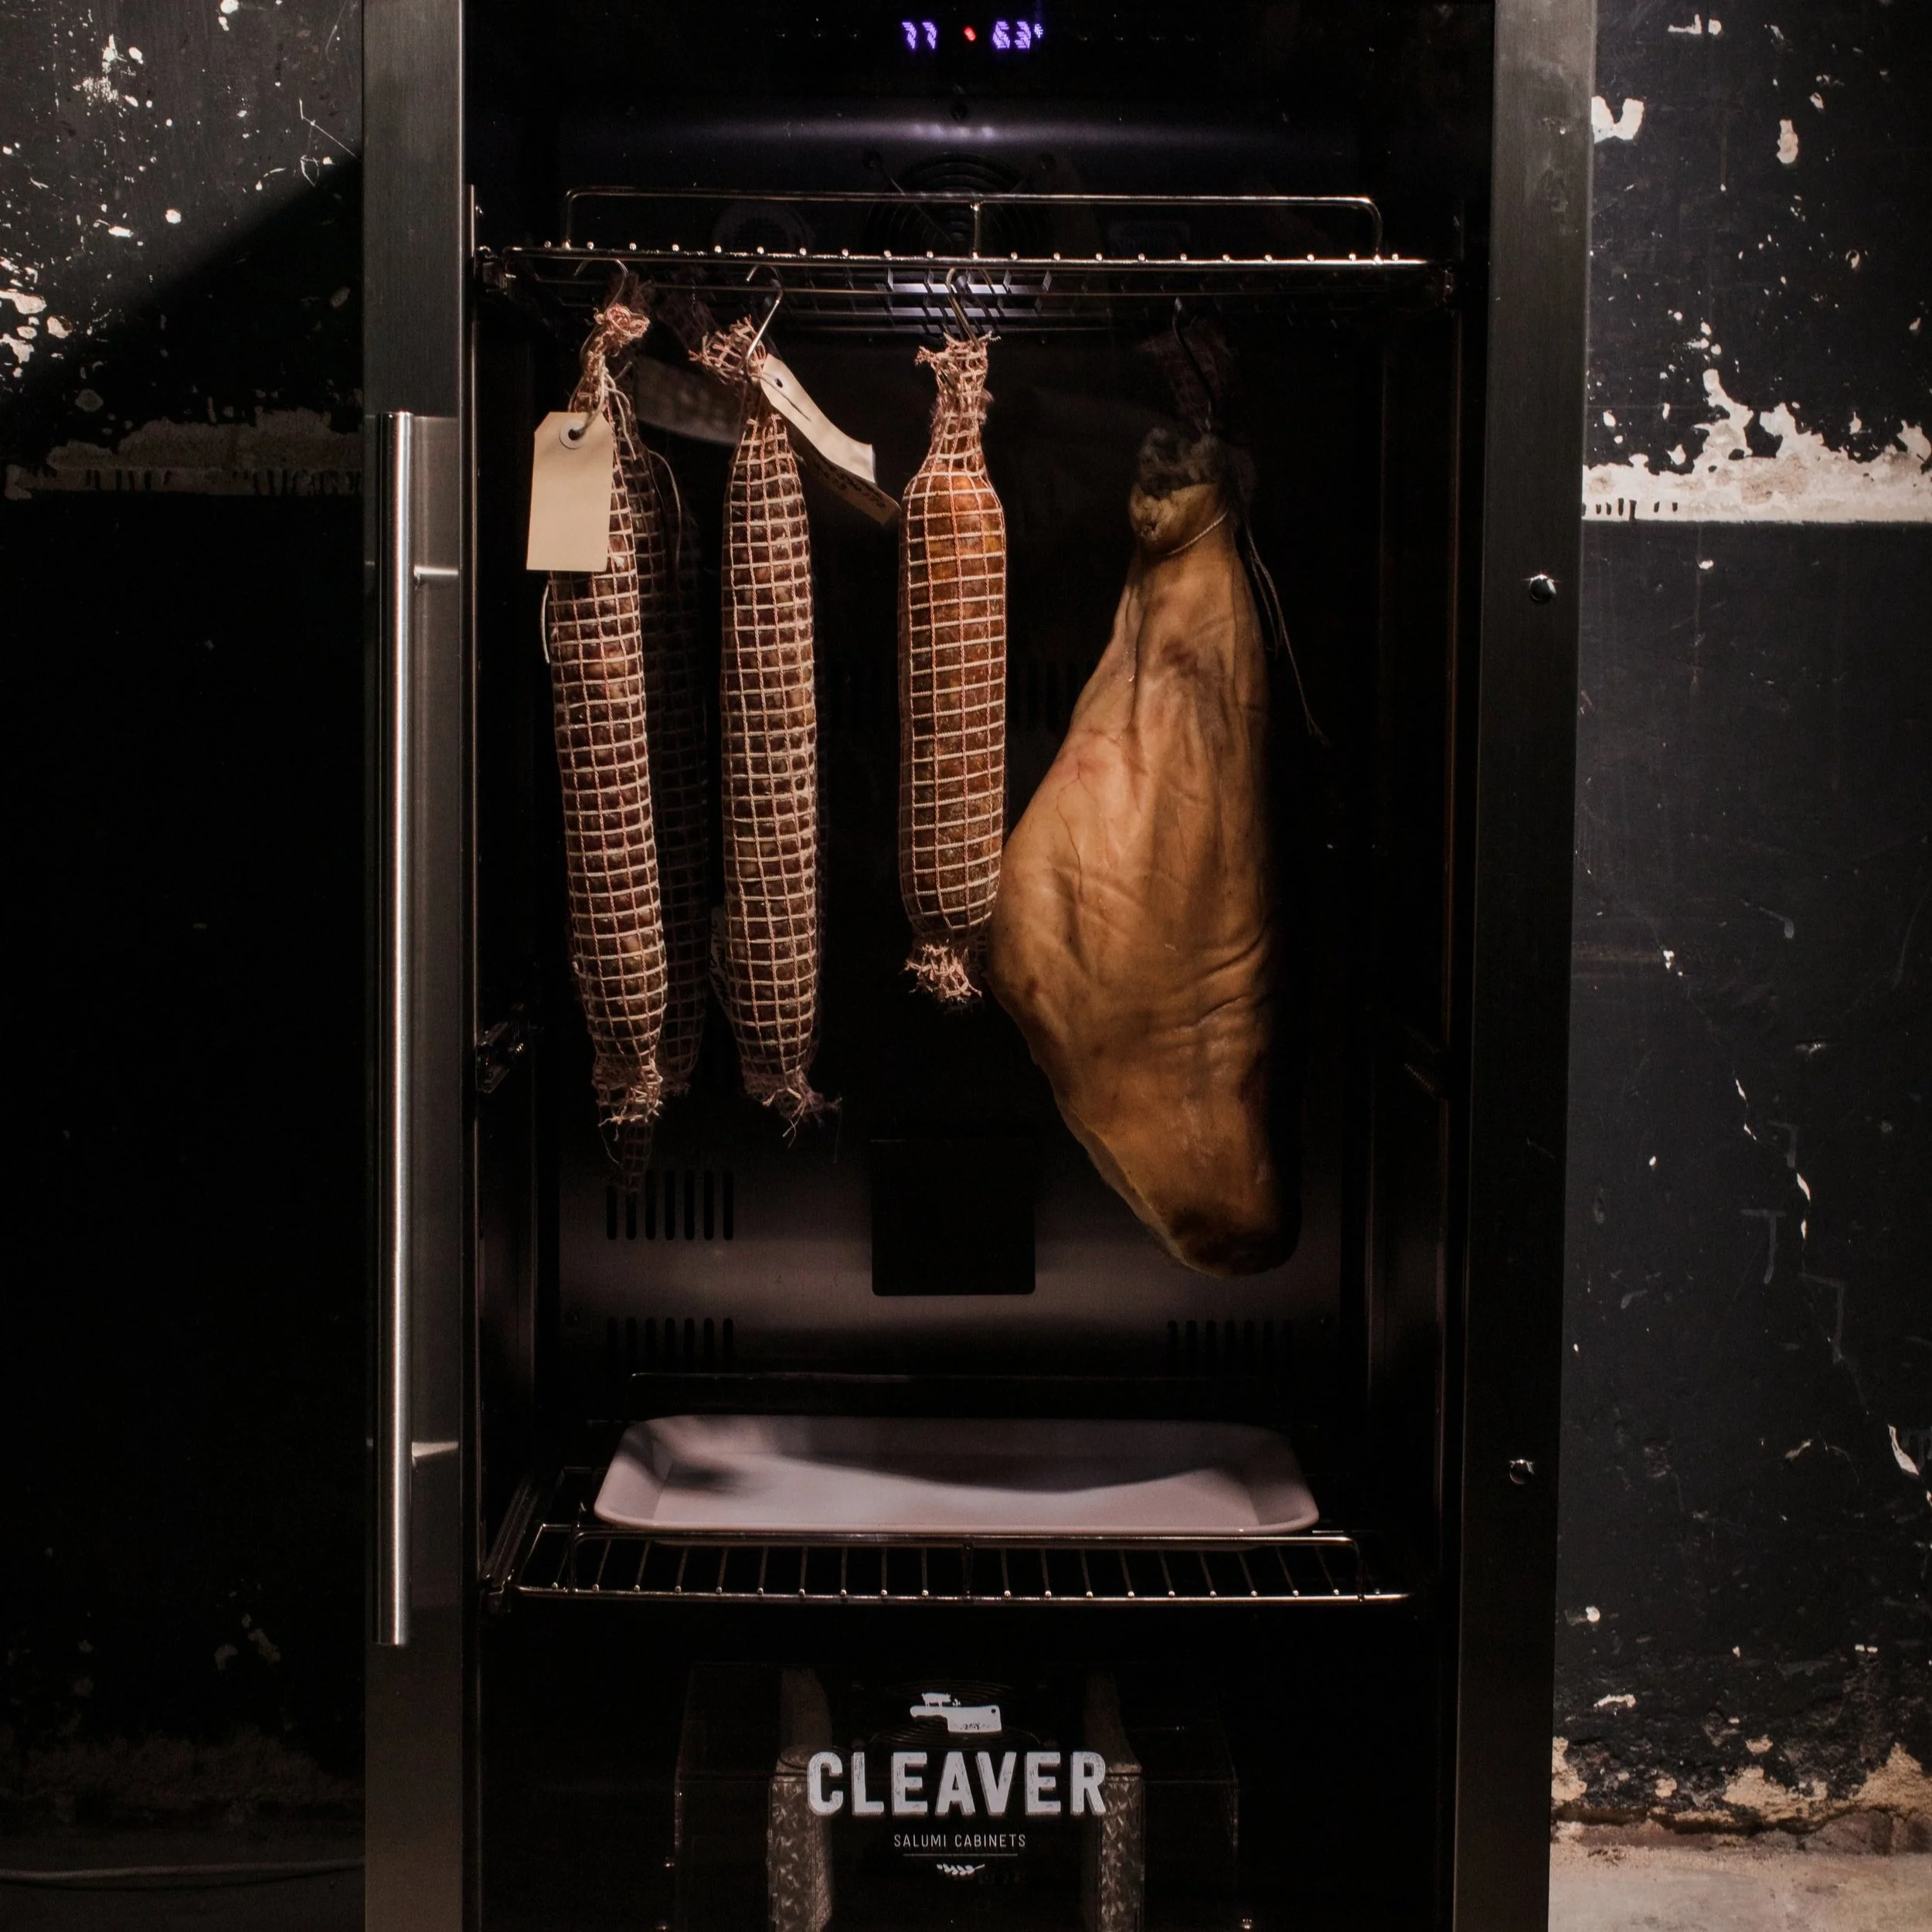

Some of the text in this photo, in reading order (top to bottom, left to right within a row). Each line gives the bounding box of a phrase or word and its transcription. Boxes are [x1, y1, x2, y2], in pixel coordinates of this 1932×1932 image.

[807, 1750, 1107, 1817] CLEAVER
[893, 1834, 1026, 1847] SALUMI CABINETS
